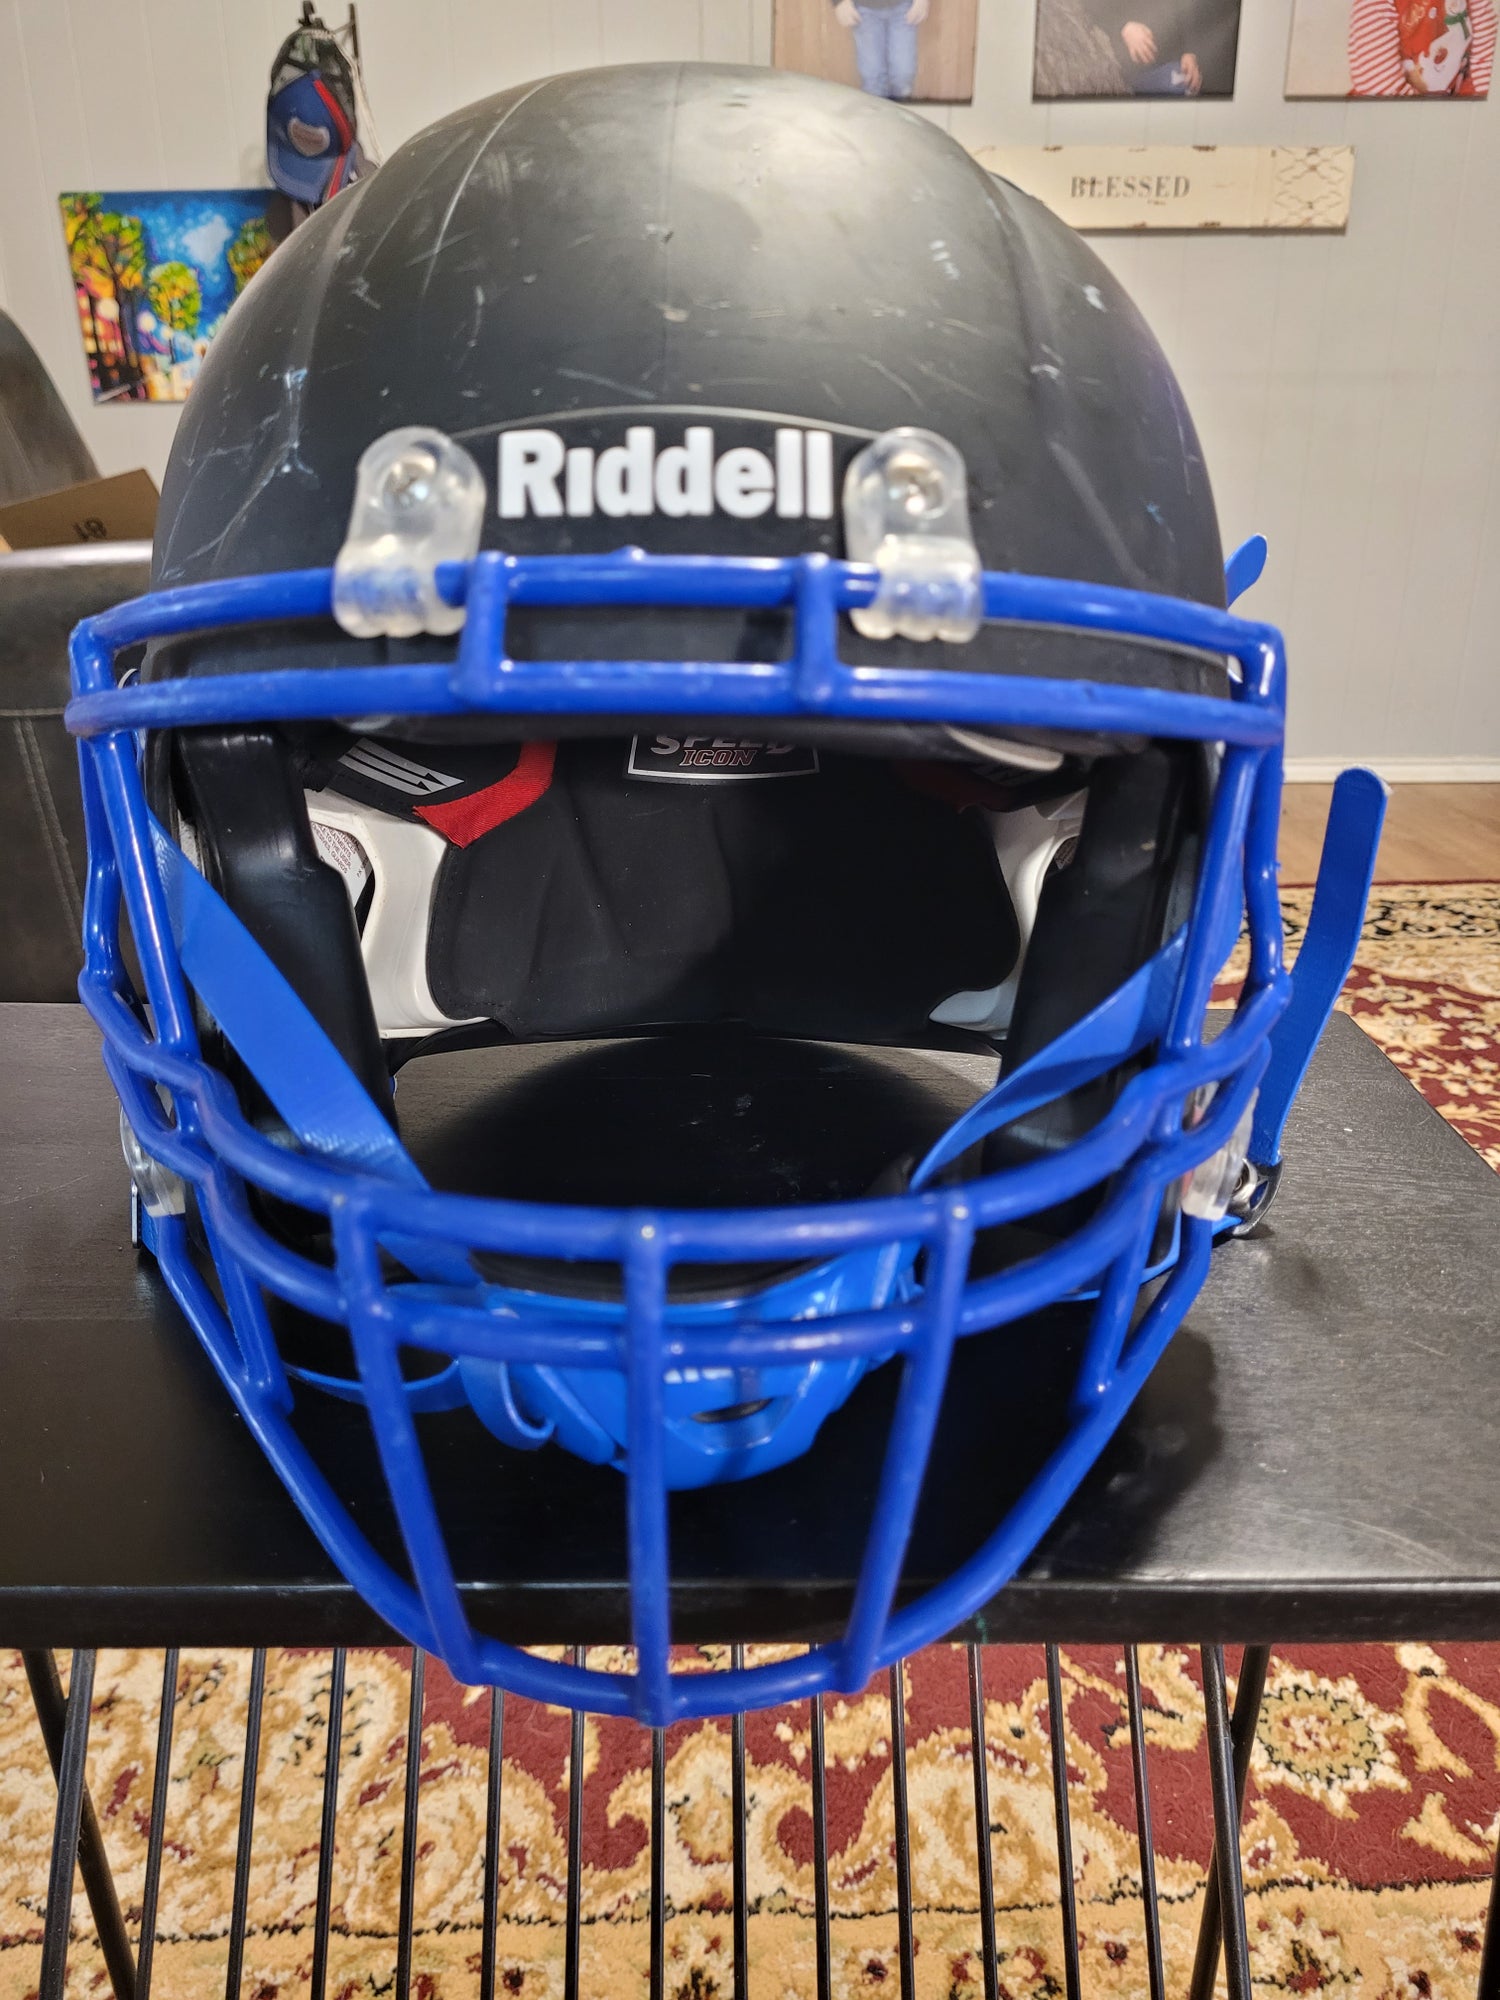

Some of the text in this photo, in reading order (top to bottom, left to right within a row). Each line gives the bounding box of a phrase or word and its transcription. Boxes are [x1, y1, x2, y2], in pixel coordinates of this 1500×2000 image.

[1071, 176, 1190, 198] BLESSED
[499, 426, 834, 519] Riddell
[679, 749, 757, 766] ICON
